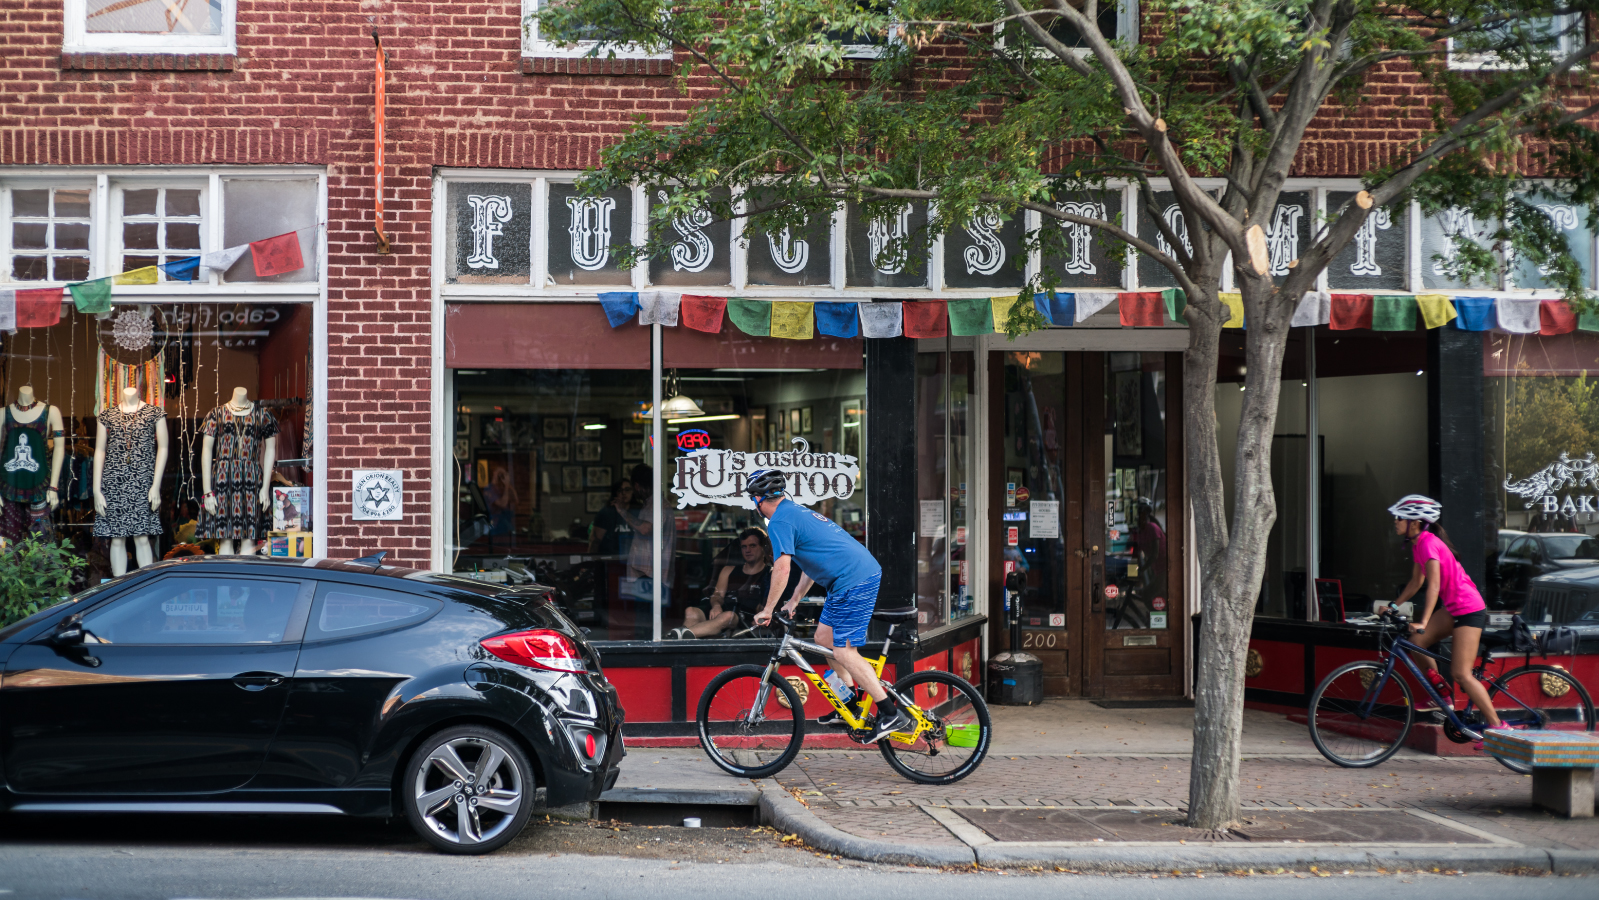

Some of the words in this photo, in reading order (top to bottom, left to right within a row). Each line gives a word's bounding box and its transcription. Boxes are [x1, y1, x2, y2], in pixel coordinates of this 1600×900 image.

[676, 450, 746, 490] FU's
[754, 443, 838, 469] custom
[355, 479, 366, 493] EDEN
[366, 473, 385, 481] ORION
[385, 475, 400, 493] REALTY
[728, 471, 853, 498] TTOO
[1543, 494, 1599, 512] BAK
[1023, 632, 1057, 648] 200
